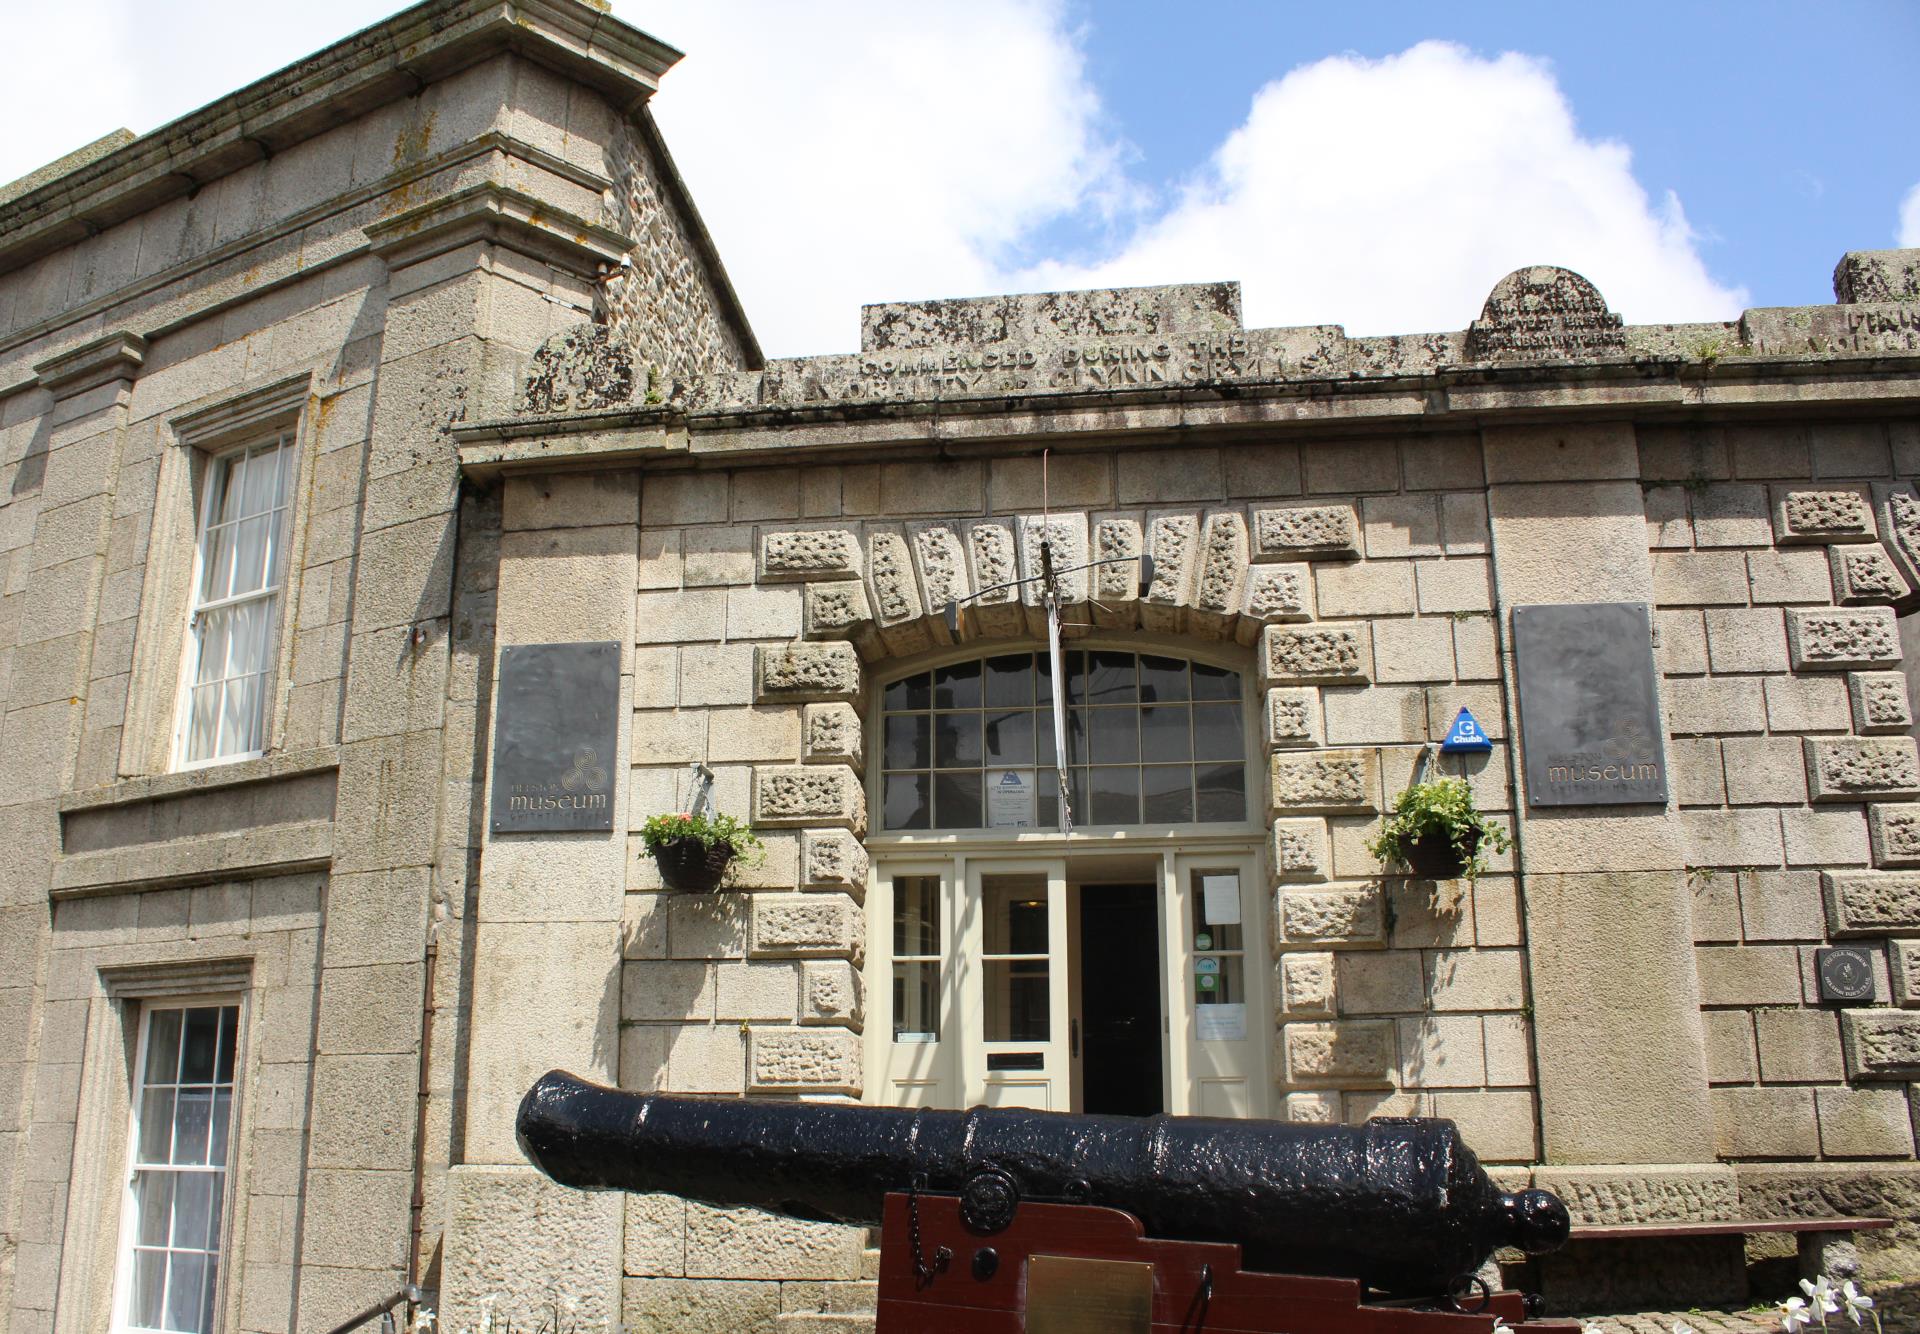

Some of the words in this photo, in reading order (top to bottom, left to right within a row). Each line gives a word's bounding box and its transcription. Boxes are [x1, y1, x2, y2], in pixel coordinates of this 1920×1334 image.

[861, 350, 1038, 376] COMMENCED
[1062, 342, 1171, 368] DURING
[1186, 336, 1247, 360] THE
[1453, 735, 1483, 743] Chubb
[1548, 764, 1658, 782] museum
[510, 795, 606, 810] museum
